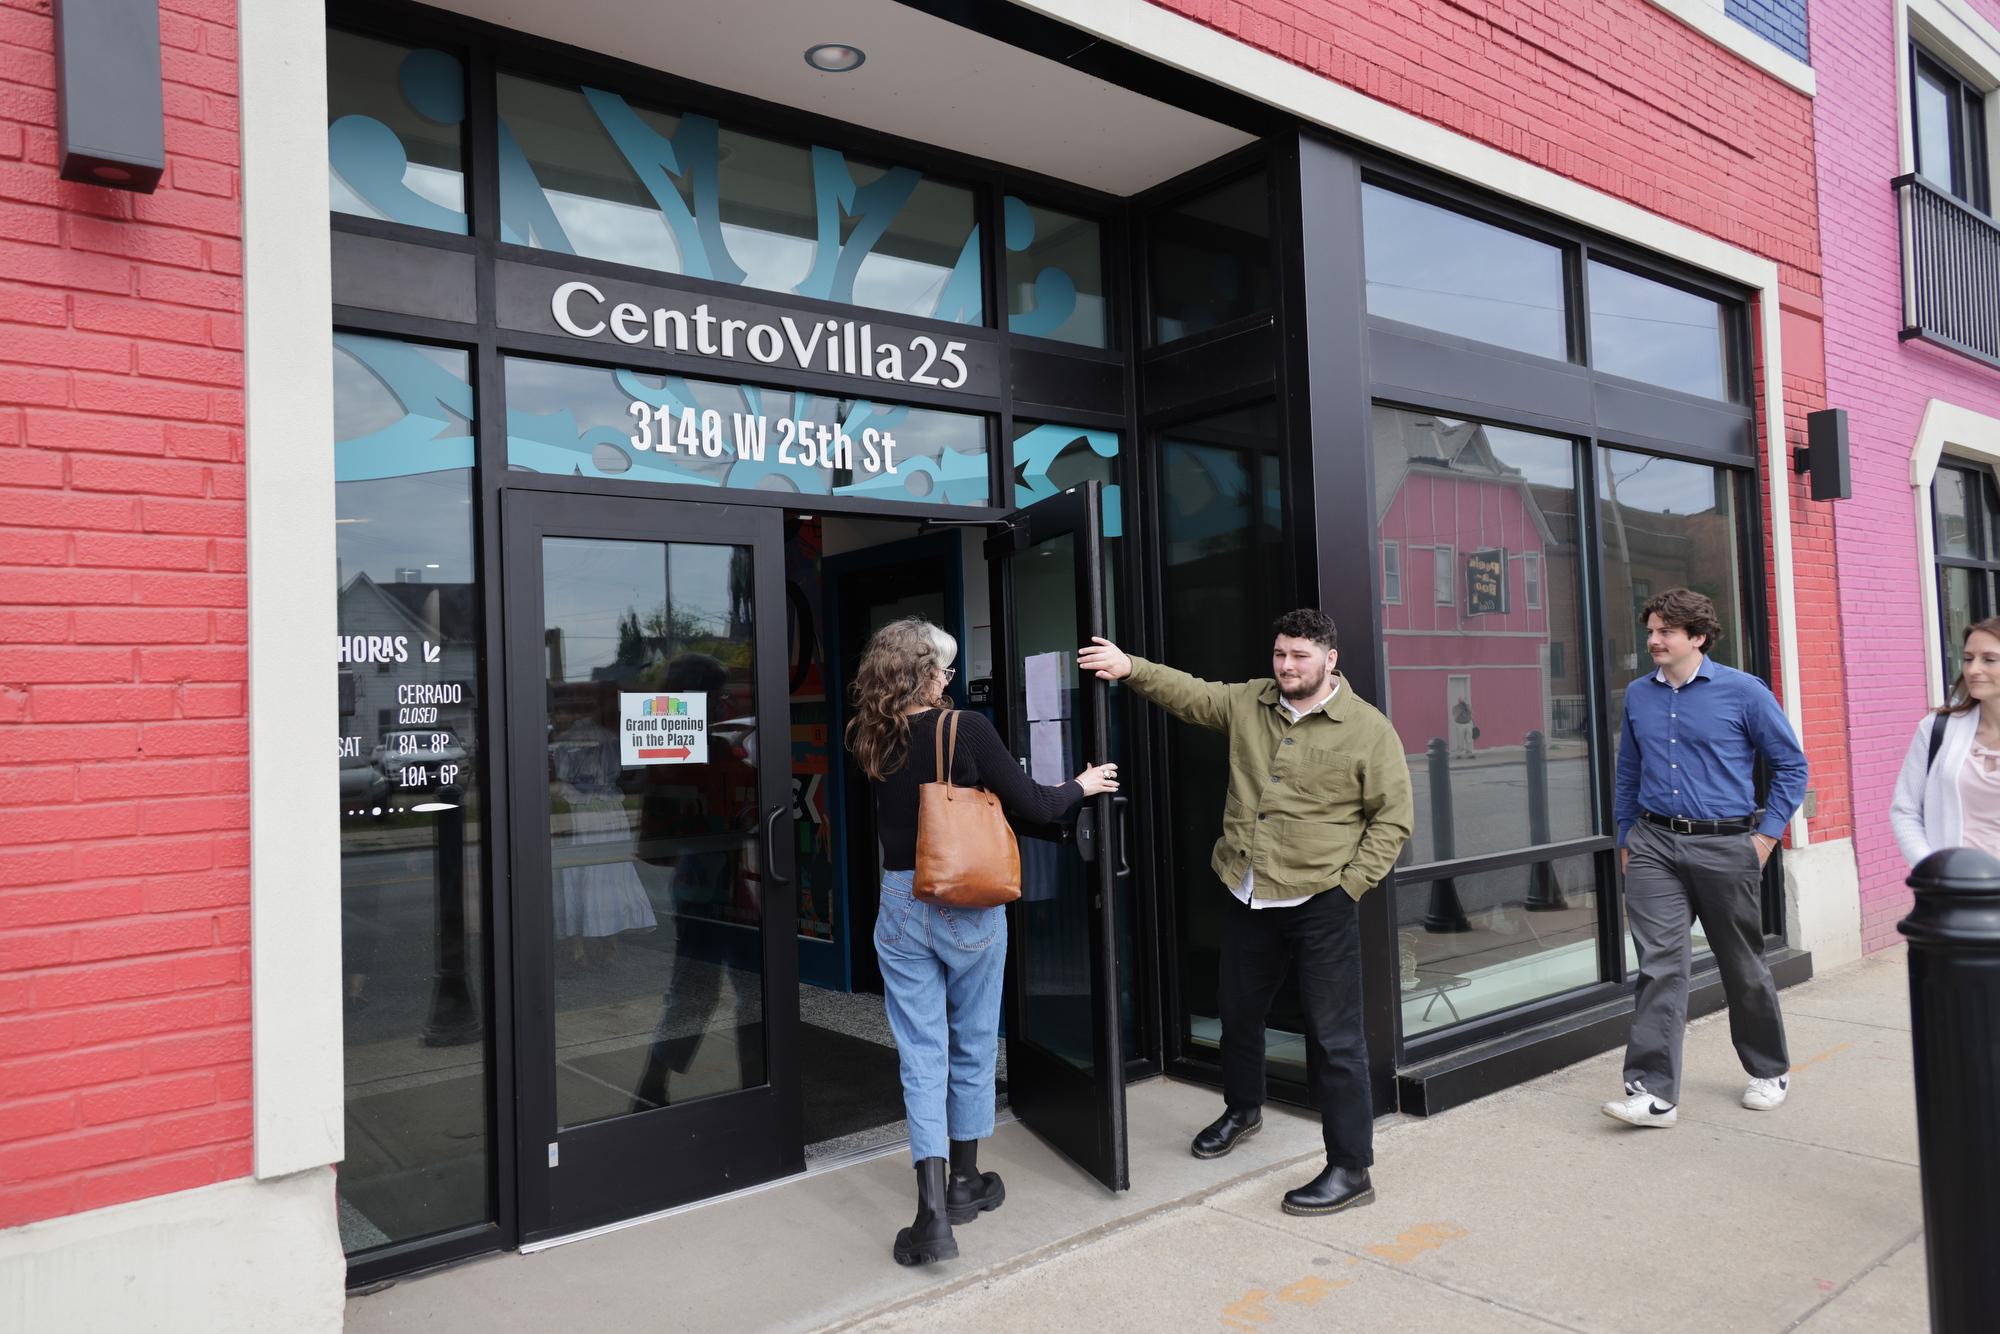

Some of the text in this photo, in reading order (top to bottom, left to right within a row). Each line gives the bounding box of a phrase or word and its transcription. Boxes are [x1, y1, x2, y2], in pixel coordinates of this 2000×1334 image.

[551, 281, 968, 389] CentroVilla25
[629, 401, 898, 474] 3140 W 25th St
[337, 635, 408, 663] HORAS
[398, 684, 461, 705] CERRADO
[399, 707, 437, 724] CLOSED
[626, 717, 704, 732] Grand Opening
[399, 734, 418, 755] 8A
[431, 733, 449, 754] 8P
[632, 733, 695, 747] in the Plaza
[399, 766, 427, 787] 10A
[440, 765, 458, 785] 6P
